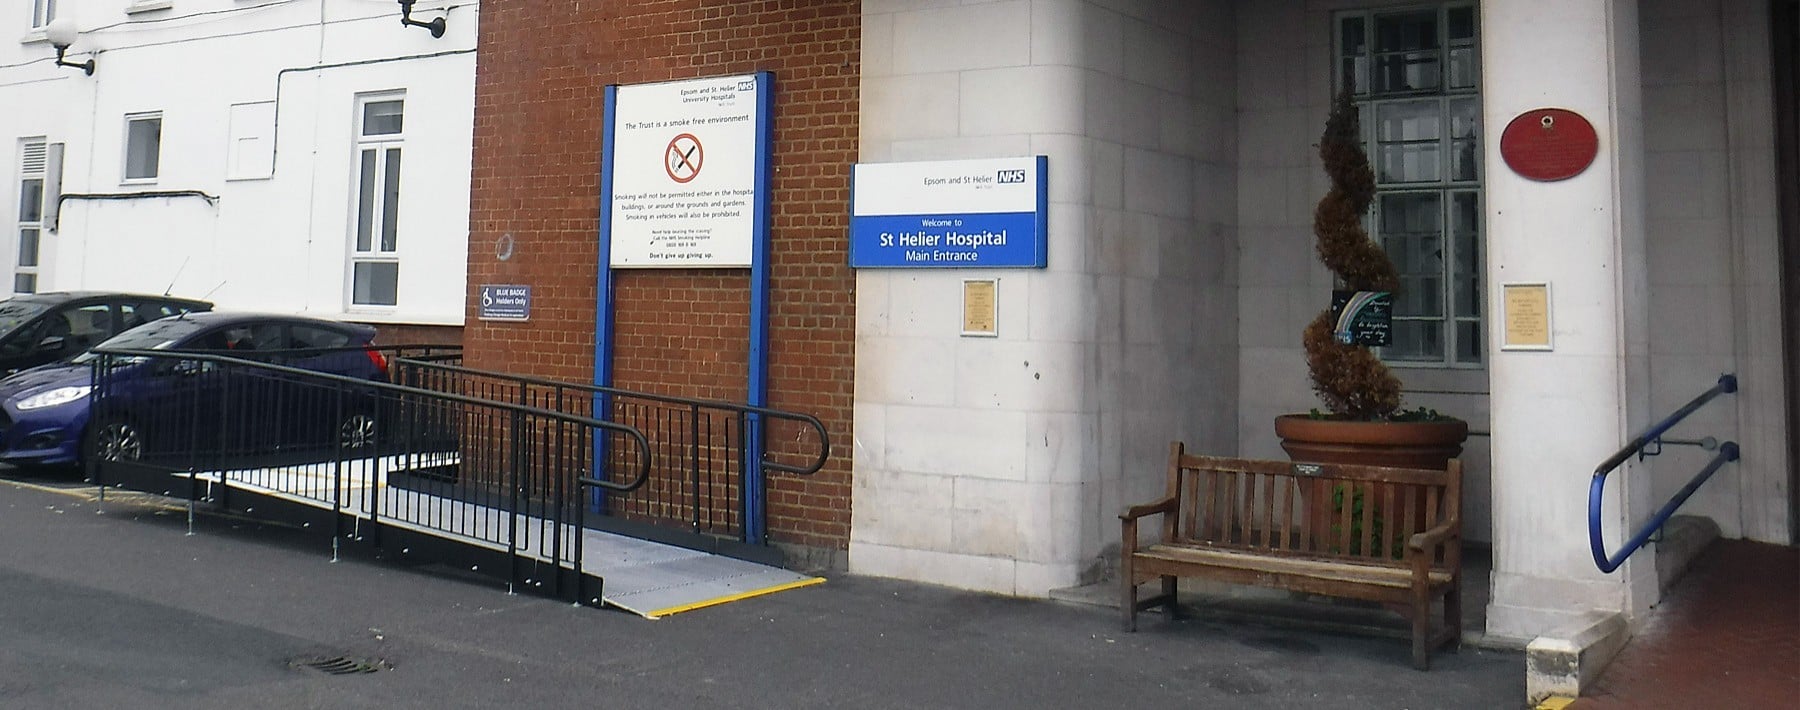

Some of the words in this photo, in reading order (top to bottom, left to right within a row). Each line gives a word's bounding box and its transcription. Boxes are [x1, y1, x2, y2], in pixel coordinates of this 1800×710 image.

[738, 82, 753, 91] NHS
[708, 114, 749, 123] environment
[924, 177, 946, 185] Epsom
[998, 170, 1025, 183] NHS
[921, 219, 952, 227] Welcome
[880, 232, 894, 246] St
[900, 232, 940, 246] Helier
[946, 230, 1006, 249] Hospital
[906, 250, 930, 261] Main
[933, 250, 978, 261] Entrance
[515, 298, 526, 306] Only
